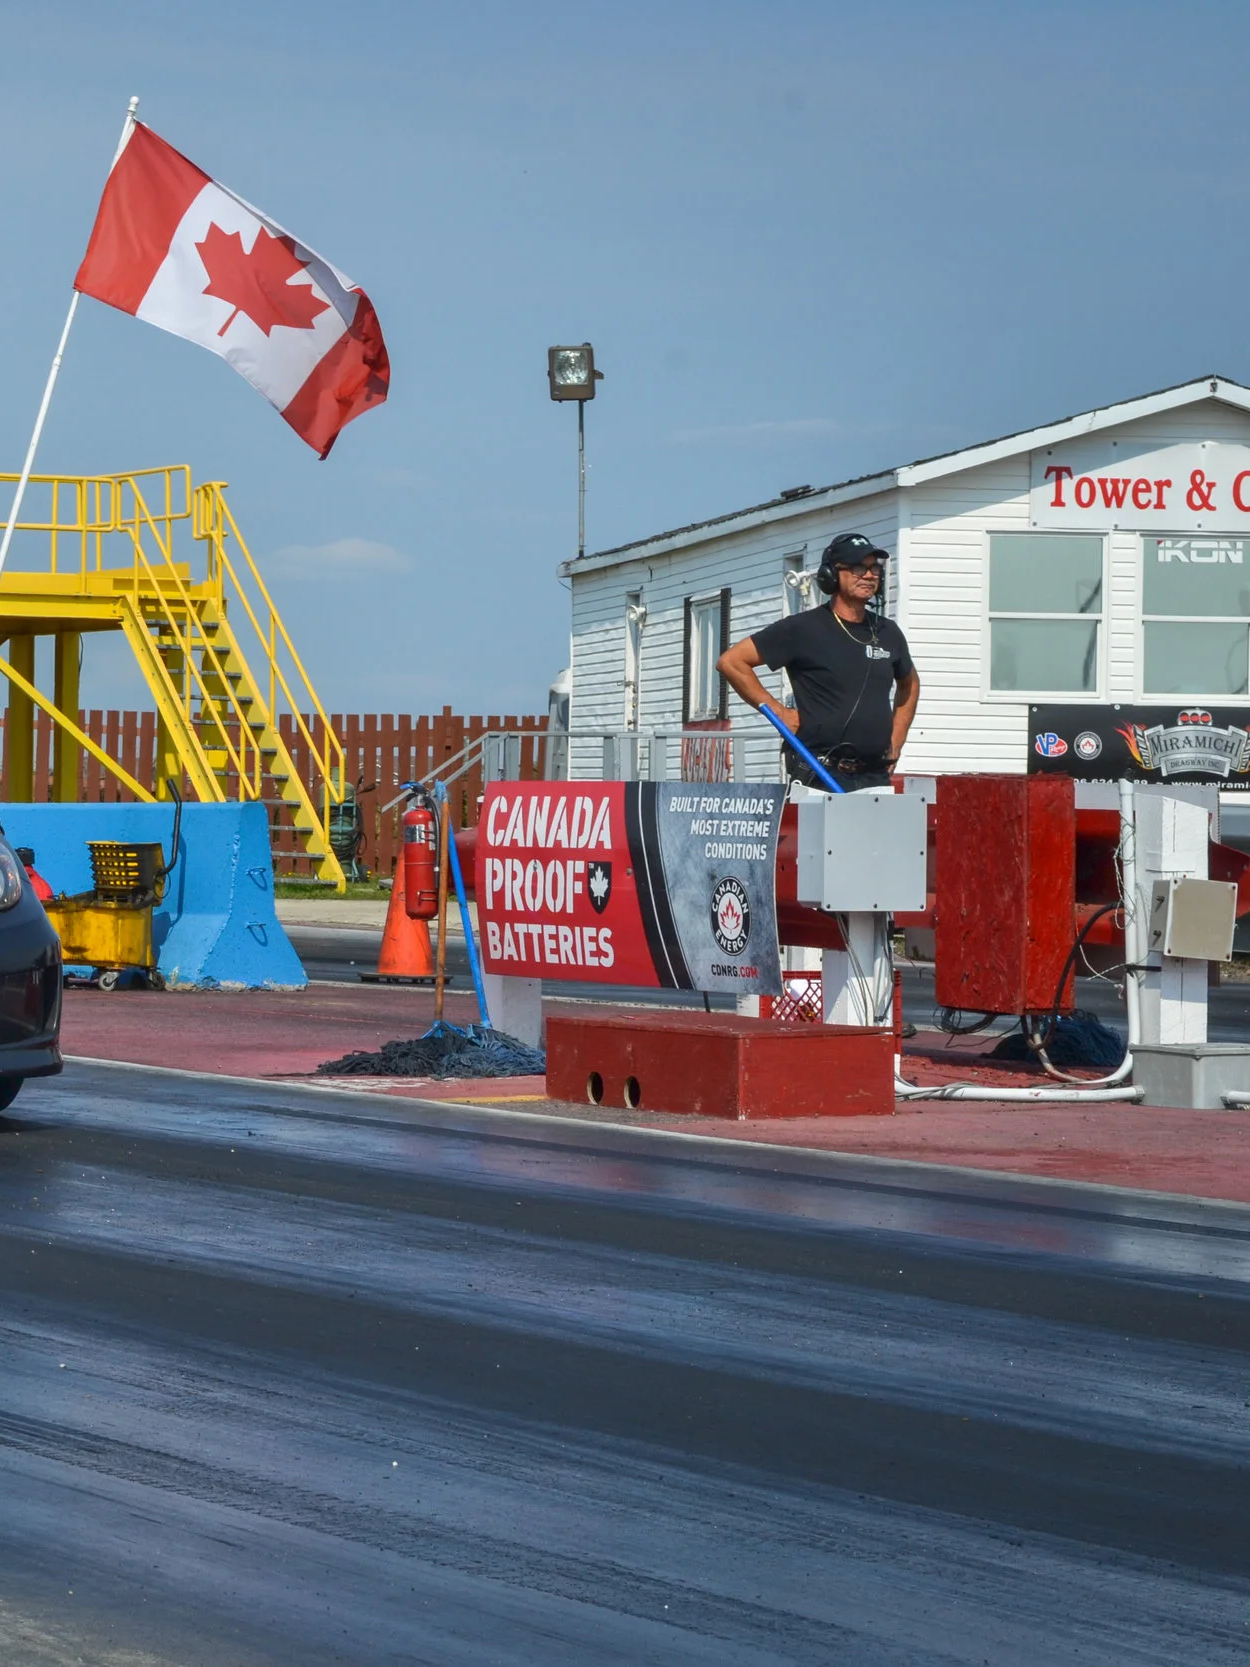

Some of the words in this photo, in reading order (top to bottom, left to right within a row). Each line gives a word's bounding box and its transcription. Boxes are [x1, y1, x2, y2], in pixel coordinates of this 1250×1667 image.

[1044, 466, 1172, 511] Tower
[1186, 469, 1217, 511] &
[1036, 733, 1058, 756] VP
[1151, 735, 1241, 757] MIRAMICHI
[1170, 759, 1207, 768] DRAGWAY
[670, 797, 699, 812] BUILT
[700, 797, 720, 813] FOR
[721, 798, 774, 814] CANADA'S
[487, 796, 612, 849] CANADA
[690, 820, 719, 835] MOST
[720, 820, 770, 837] EXTREME
[705, 843, 767, 860] CONDITIONS
[485, 858, 585, 913] PROOF
[712, 881, 749, 913] CANADIAN
[486, 922, 615, 967] BATTERIES
[715, 930, 747, 951] ENERGY
[711, 964, 758, 978] CDNRG.COM
